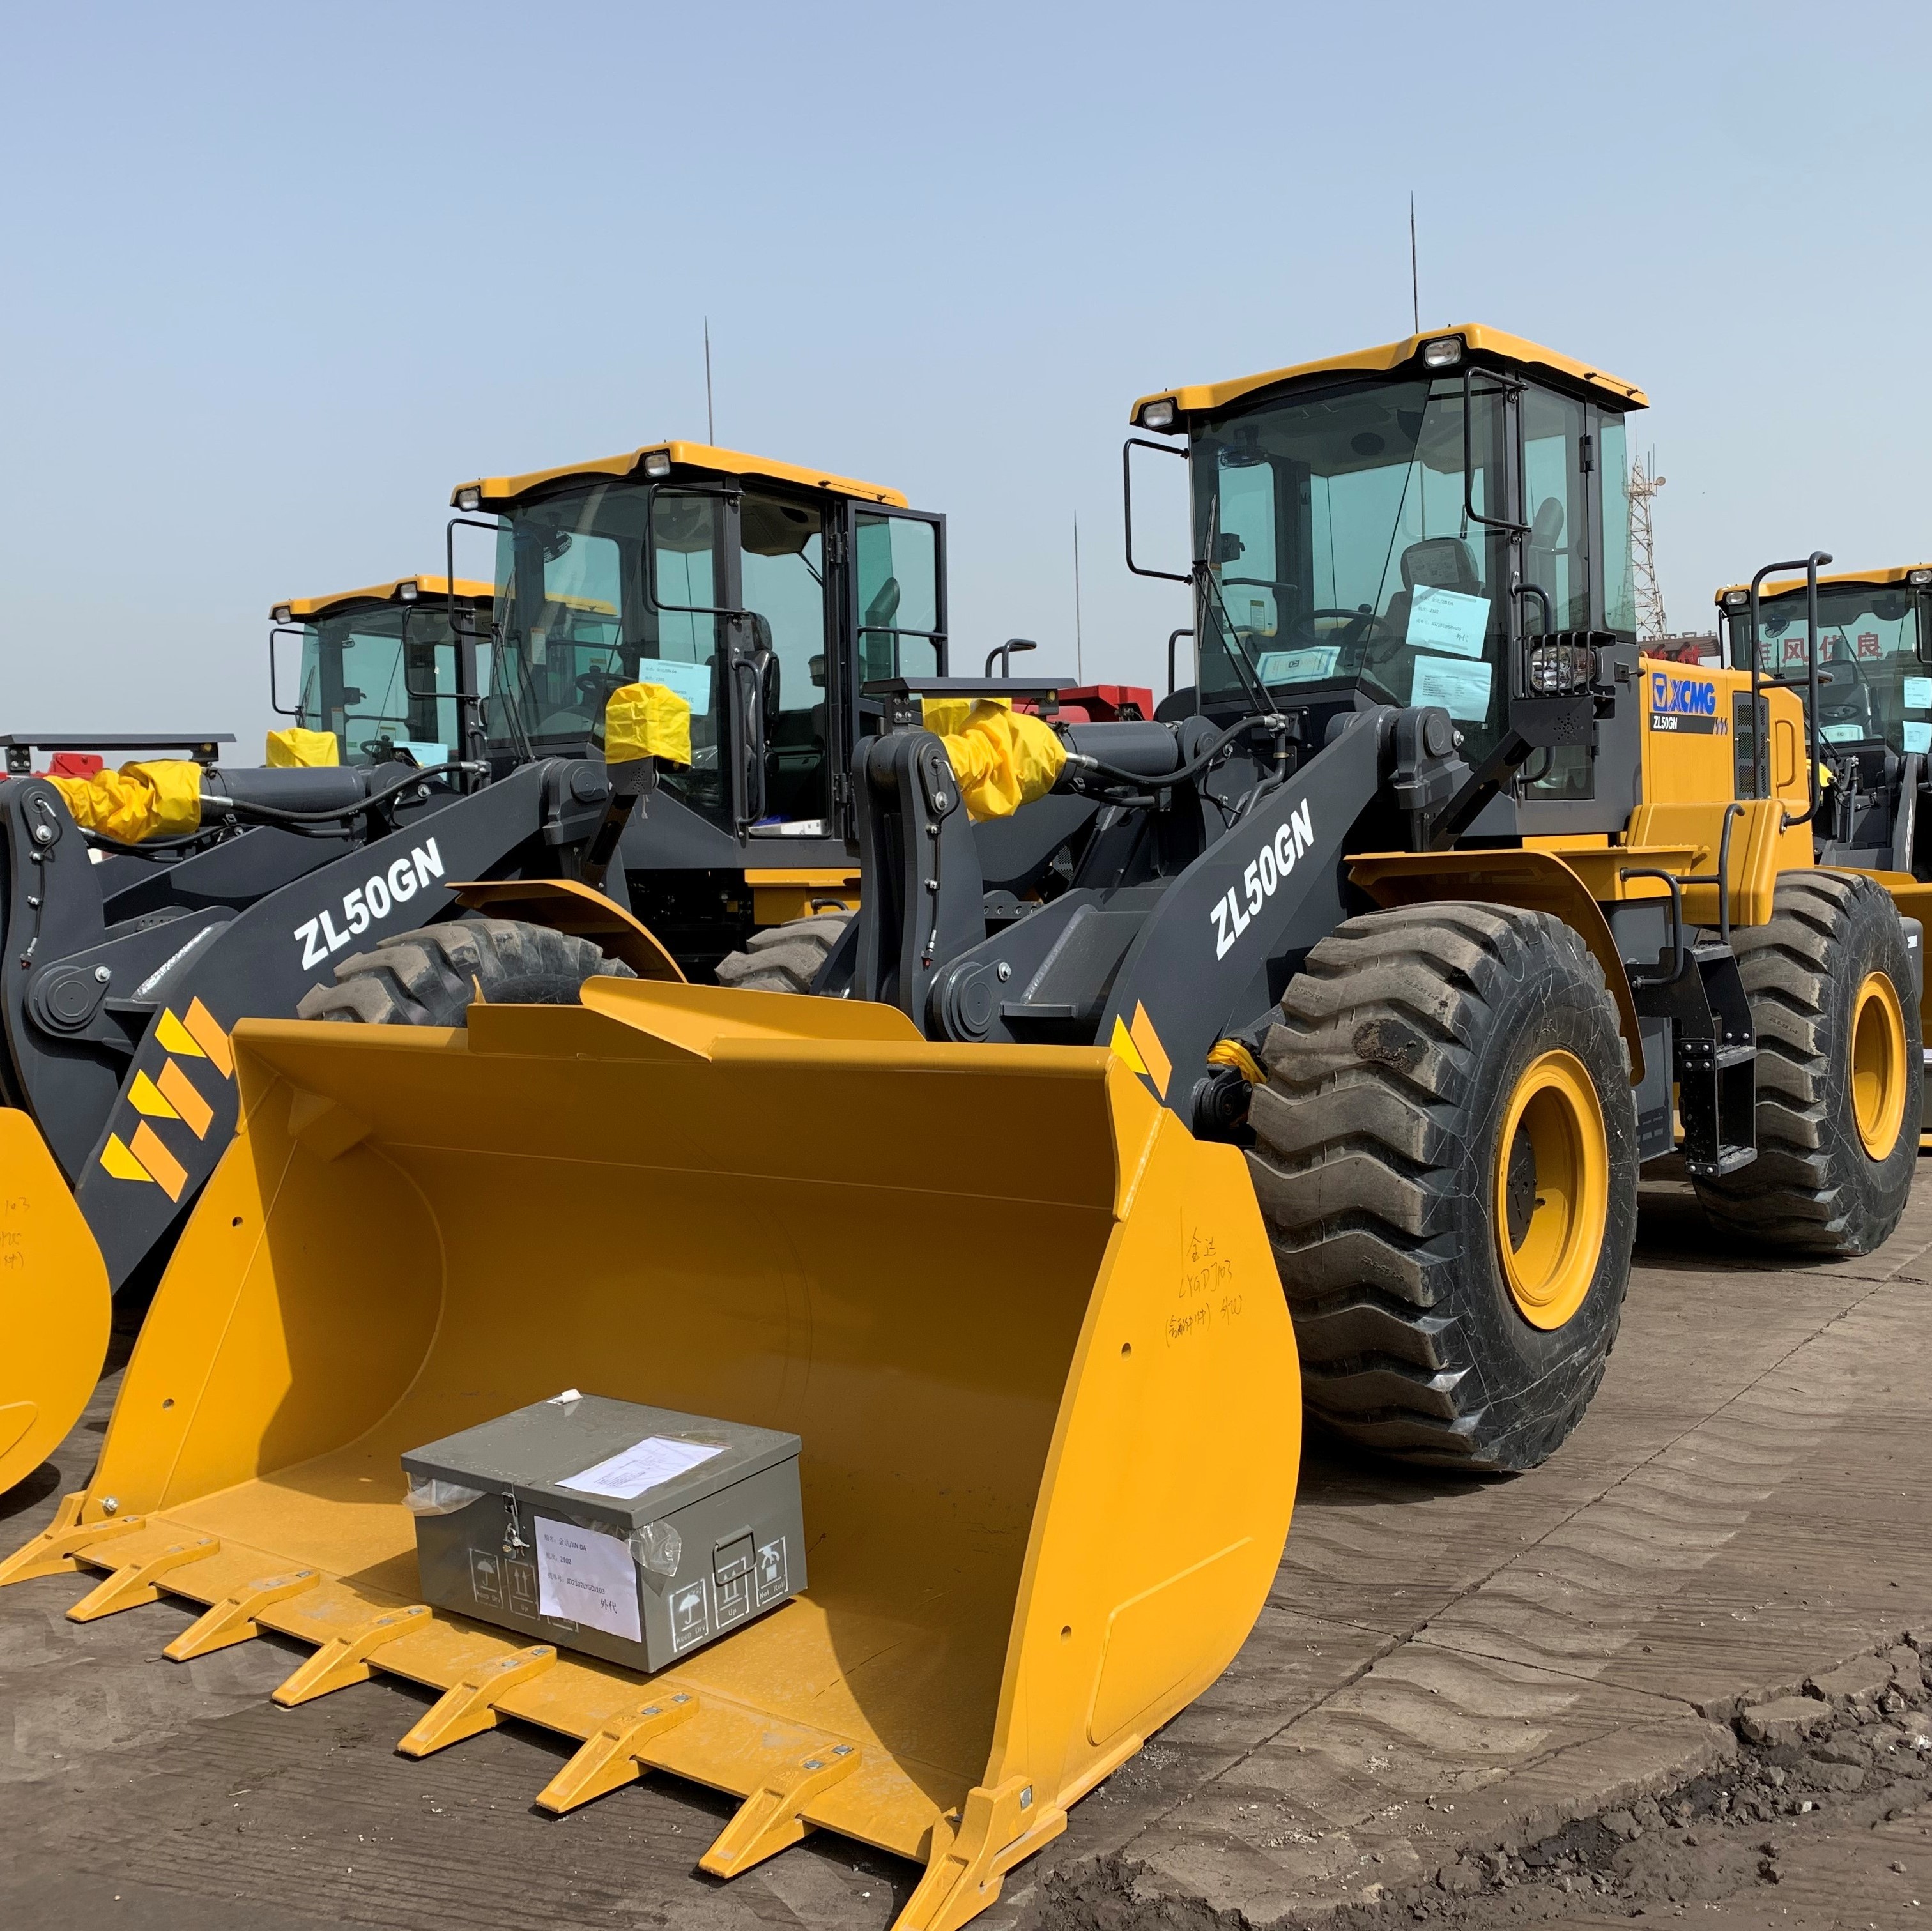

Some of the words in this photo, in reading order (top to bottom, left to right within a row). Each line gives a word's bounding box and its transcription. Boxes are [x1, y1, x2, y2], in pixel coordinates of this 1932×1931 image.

[1668, 679, 1716, 715] XCMG
[1653, 715, 1678, 730] ZL50GN
[1210, 798, 1314, 961] ZL50GN
[293, 837, 445, 972] ZL50GN
[560, 1556, 572, 1565] 2102
[759, 1591, 770, 1599] Not
[520, 1604, 529, 1612] Up
[600, 1599, 617, 1614] 外代
[728, 1607, 737, 1616] Up
